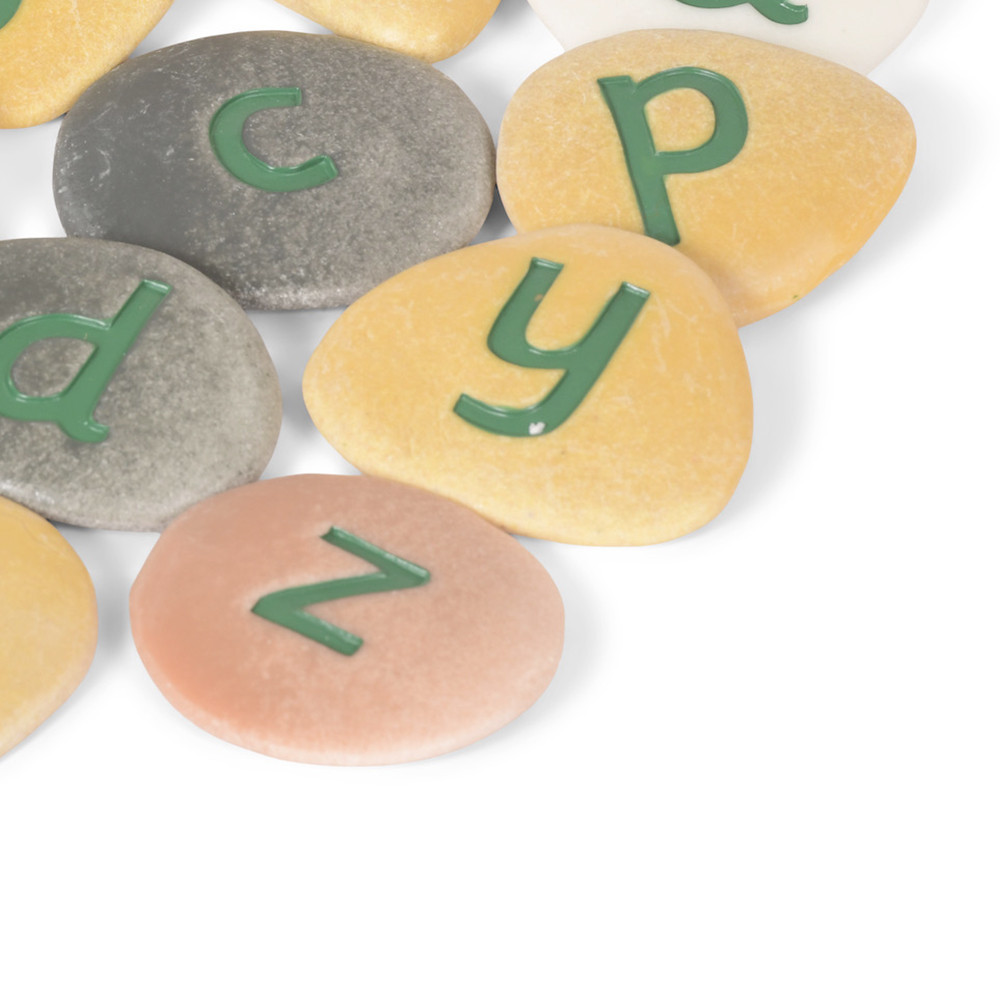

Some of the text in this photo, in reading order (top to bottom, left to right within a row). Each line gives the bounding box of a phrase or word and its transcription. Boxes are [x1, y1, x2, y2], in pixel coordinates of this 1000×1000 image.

[208, 87, 338, 193] c
[597, 66, 749, 246] p
[453, 257, 651, 437] y
[250, 526, 430, 656] z
